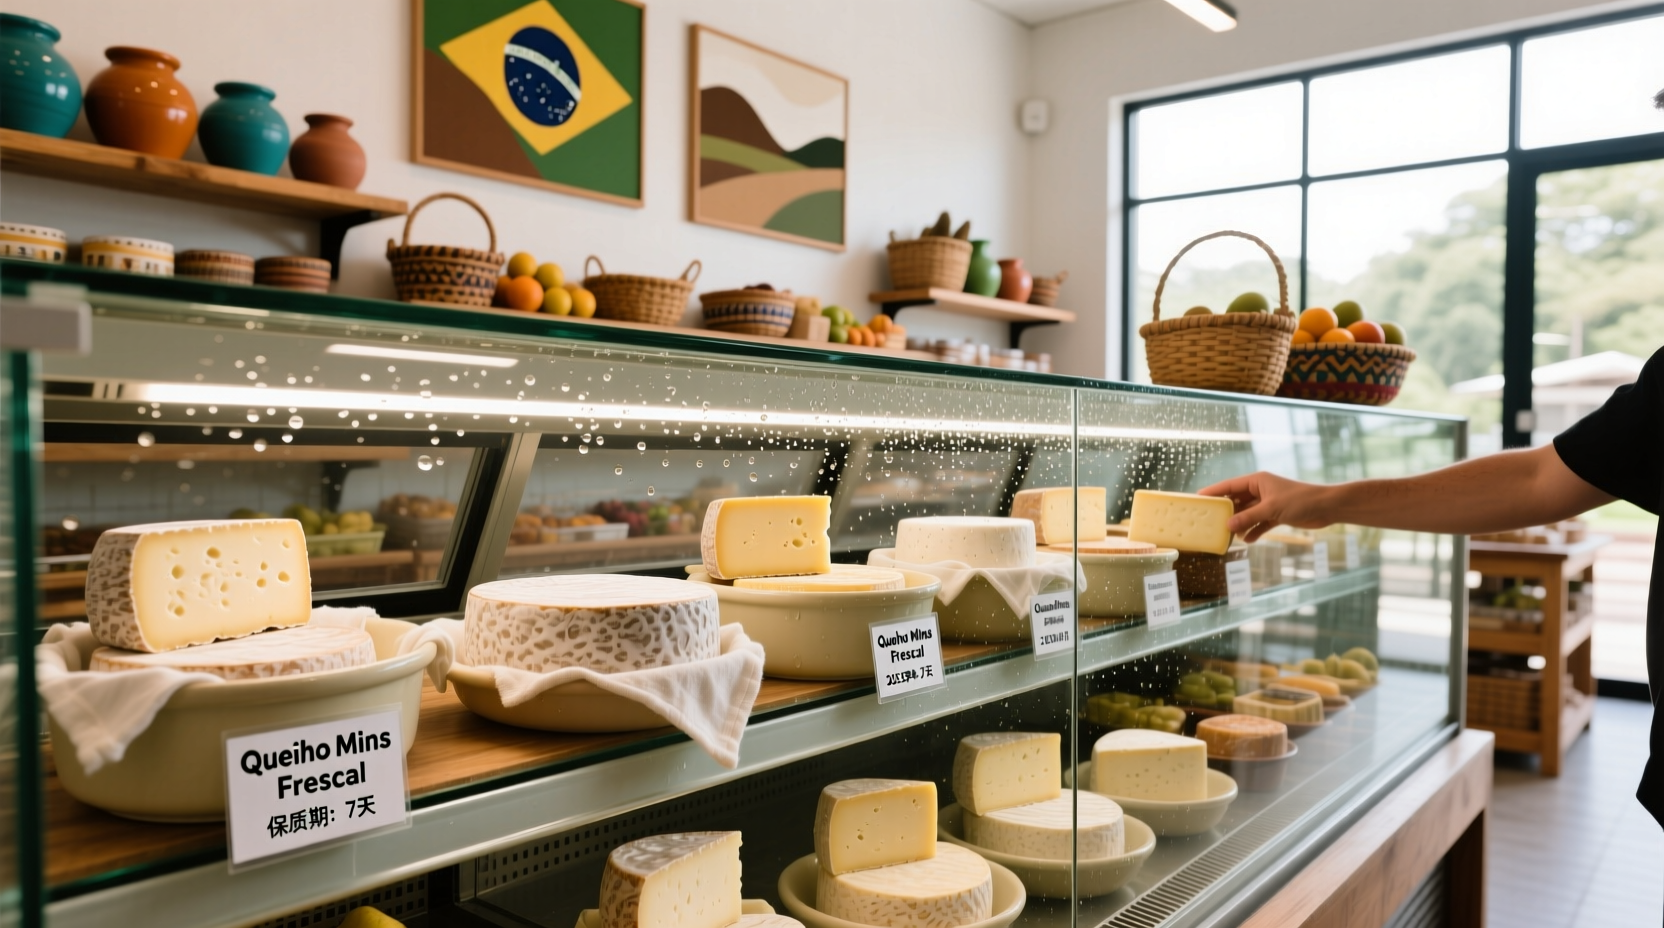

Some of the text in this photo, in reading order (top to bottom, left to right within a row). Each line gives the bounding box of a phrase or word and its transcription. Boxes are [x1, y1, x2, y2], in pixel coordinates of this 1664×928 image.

[241, 730, 391, 776] Queiho Mins
[278, 761, 366, 799] Frescal
